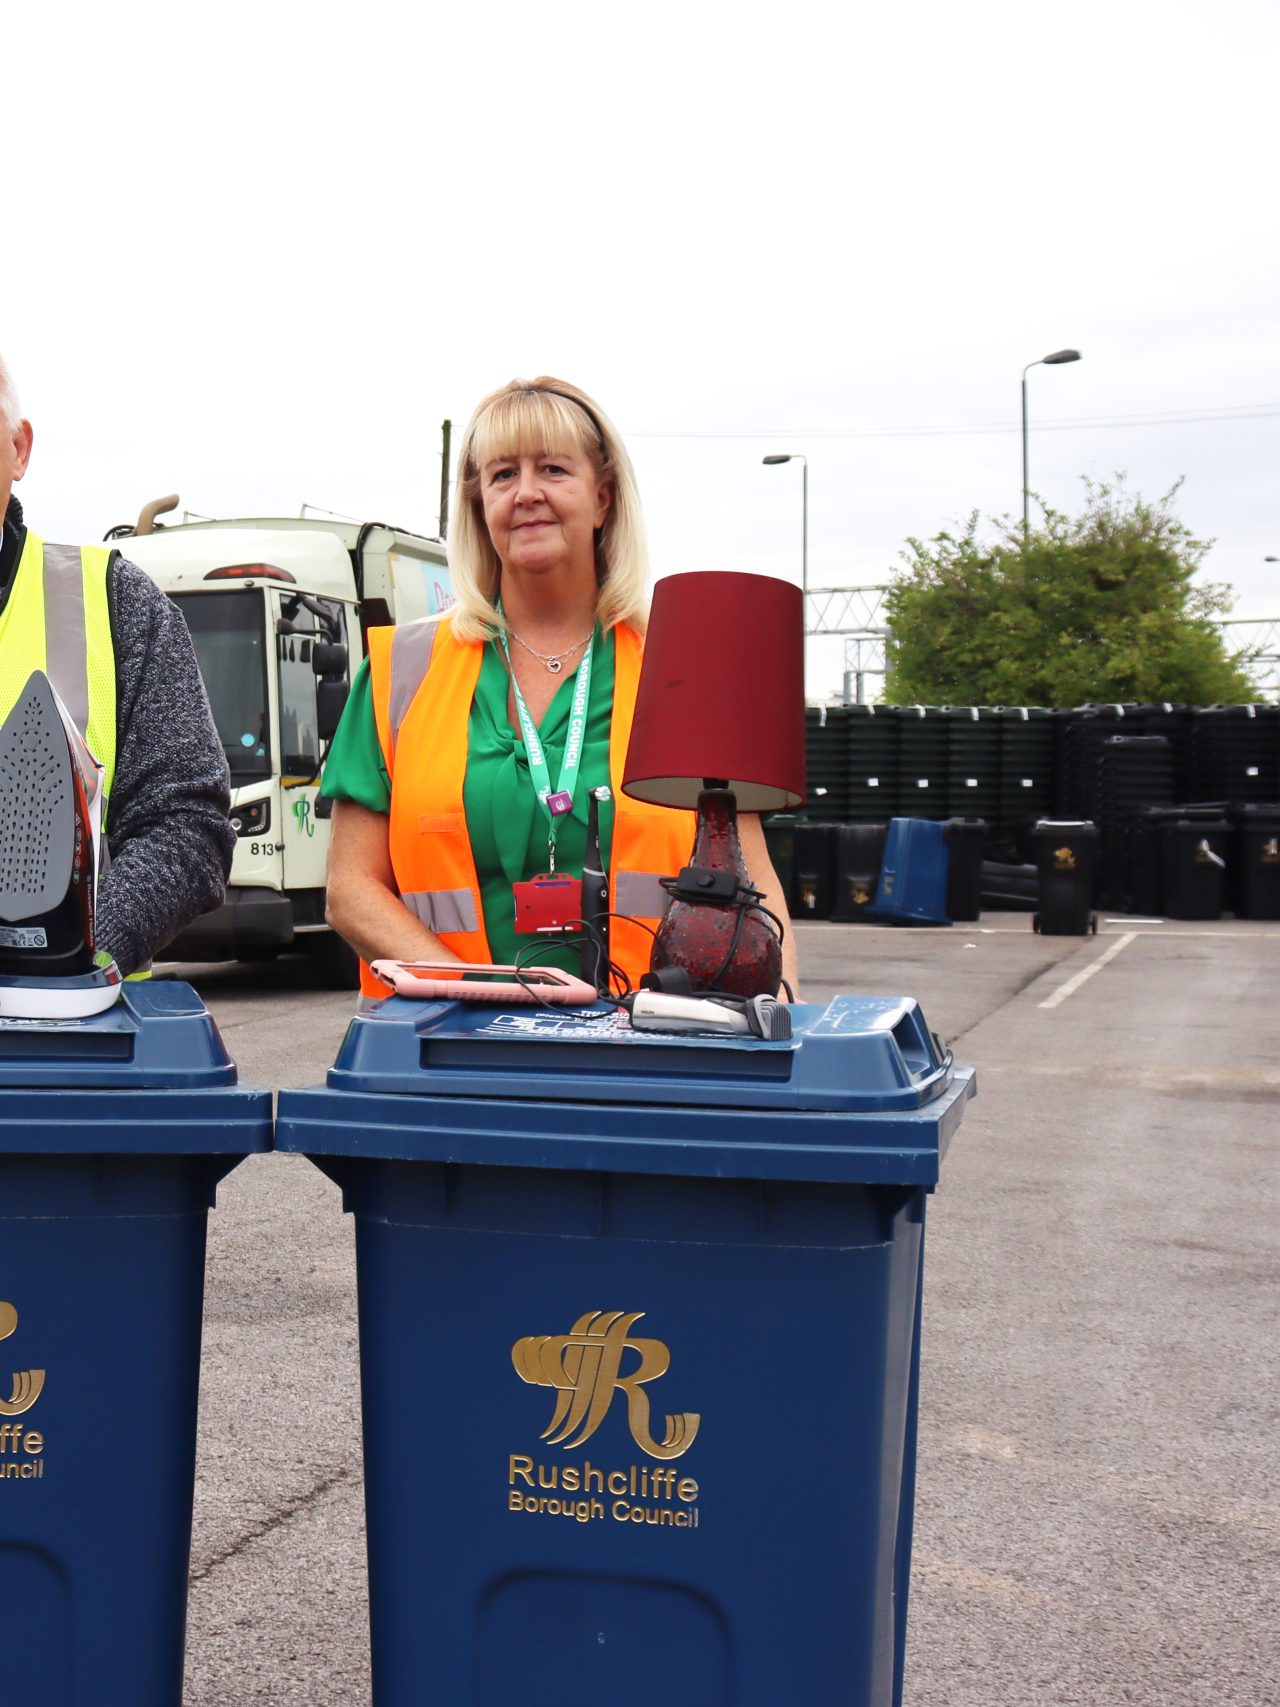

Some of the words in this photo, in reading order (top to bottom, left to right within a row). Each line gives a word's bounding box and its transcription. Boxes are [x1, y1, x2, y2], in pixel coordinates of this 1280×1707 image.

[573, 657, 589, 716] BOROUGH
[518, 699, 543, 766] RUSHCLIFFE
[565, 718, 583, 769] COUNCIL
[251, 843, 274, 856] 813
[509, 1454, 699, 1503] Rushcliffe
[508, 1489, 605, 1523] Borough
[611, 1499, 699, 1528] Council
